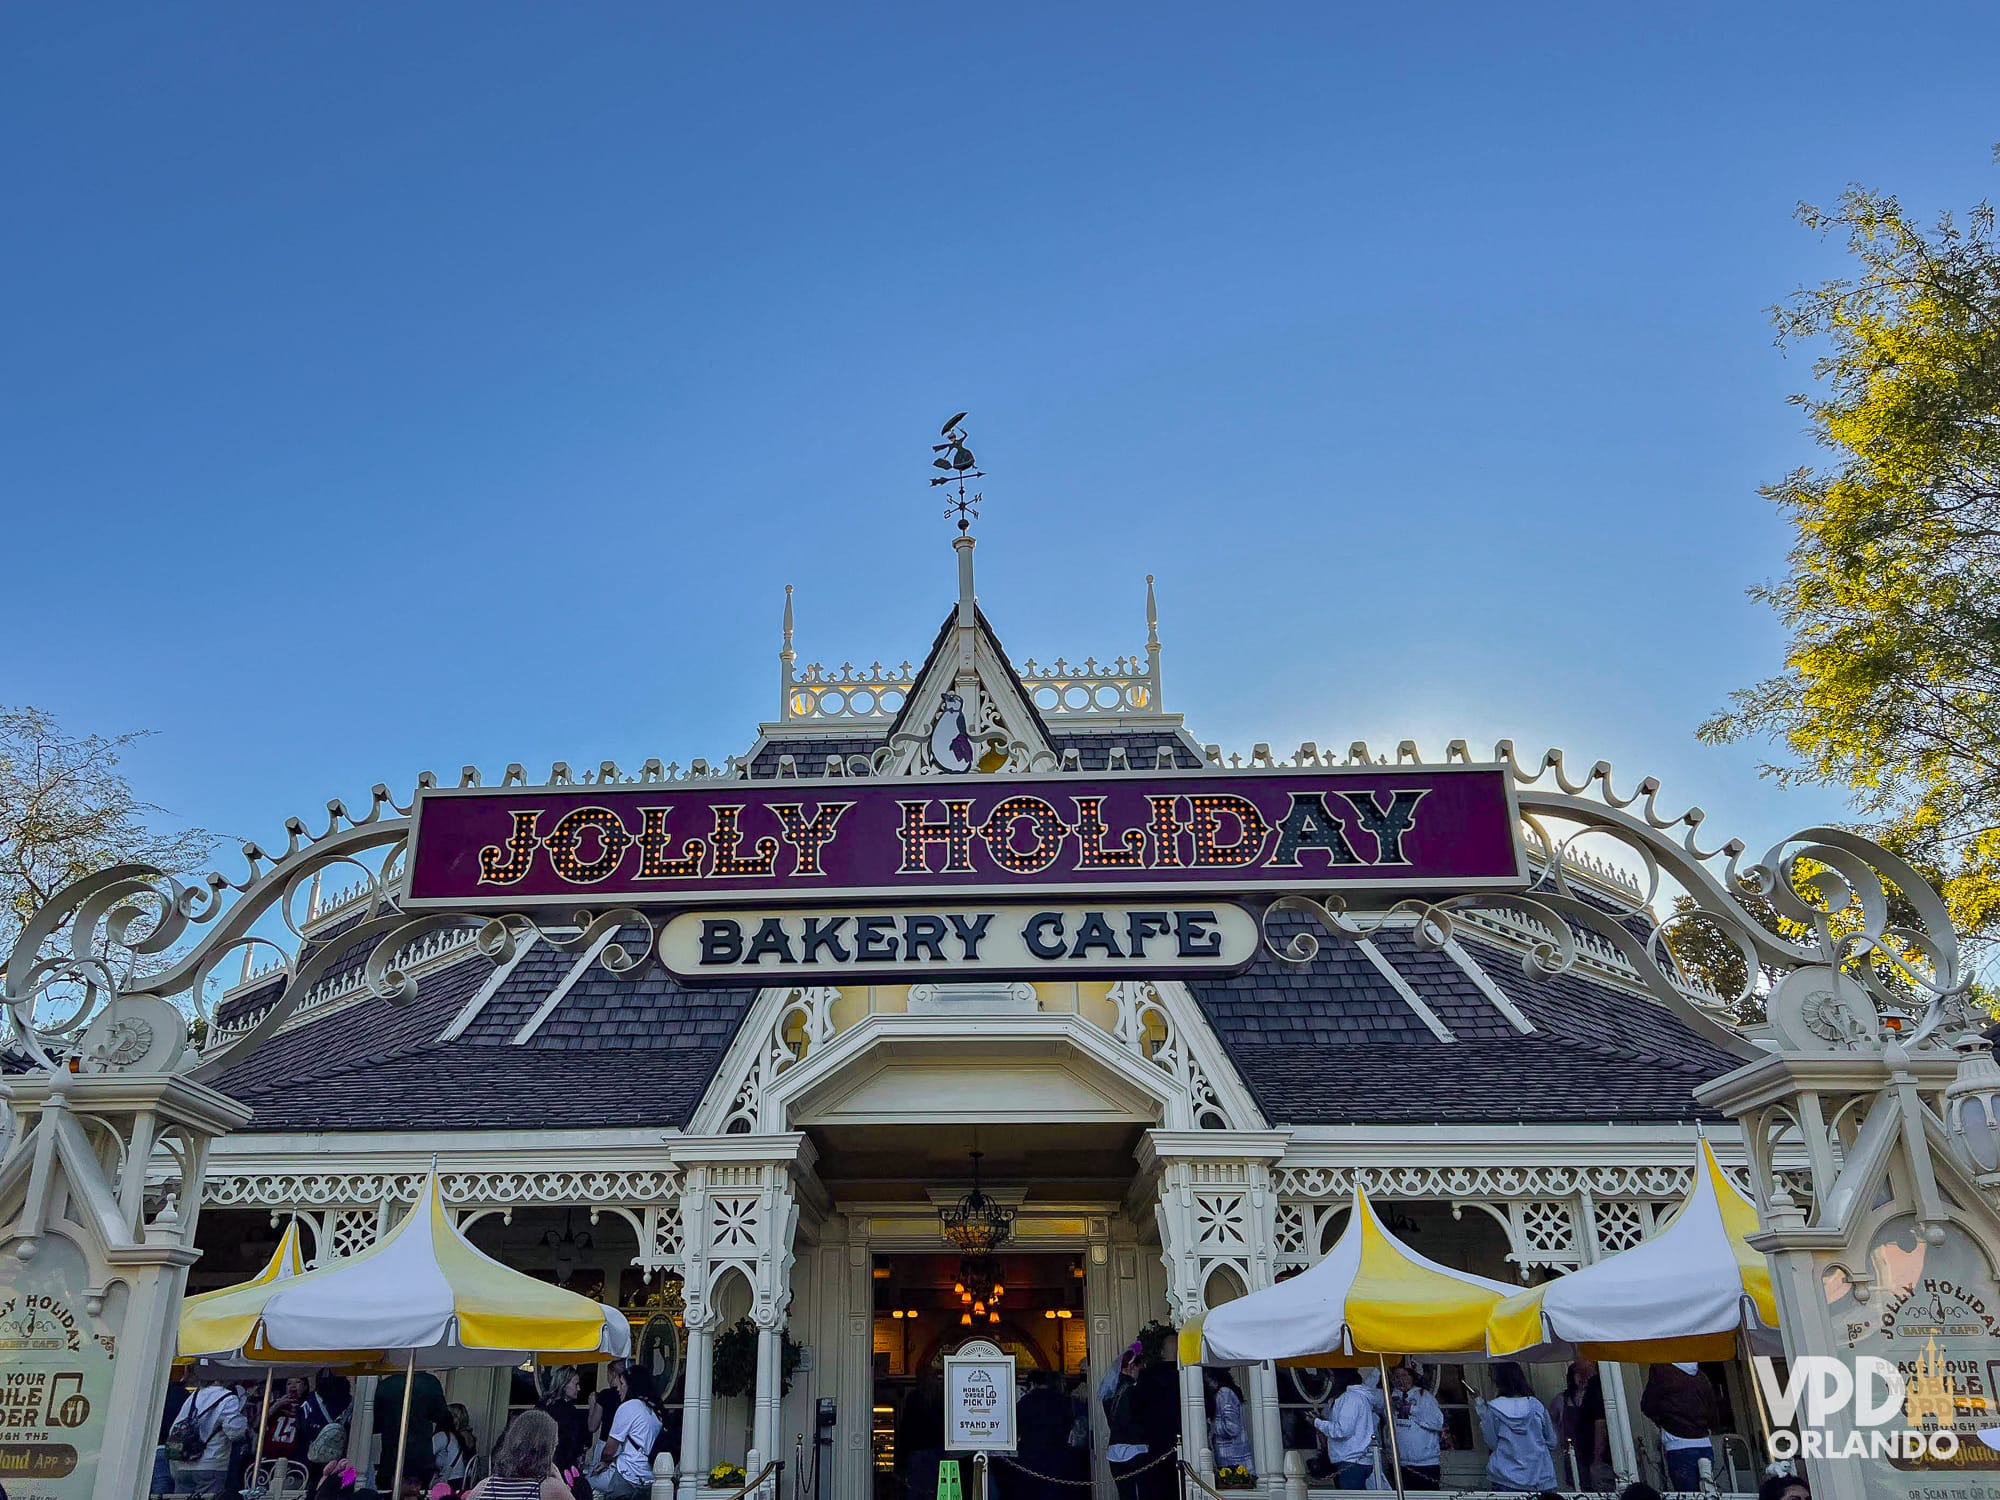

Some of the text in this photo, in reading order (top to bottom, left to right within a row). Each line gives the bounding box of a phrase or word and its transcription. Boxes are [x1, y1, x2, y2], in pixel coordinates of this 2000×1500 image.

[476, 788, 1433, 886] JOLLY HOLIDAY
[699, 910, 1224, 966] BAKERY CAFE
[1880, 1279, 2000, 1340] JOLLY HOLIDAY
[25, 1294, 80, 1353] HOLIDAY
[1934, 1360, 1980, 1374] YOUR
[7, 1373, 46, 1386] YOUR
[963, 1399, 997, 1407] PICK UP
[960, 1421, 1000, 1429] STAND BY
[1913, 1422, 1976, 1432] THROUGH
[24, 1432, 49, 1441] THE
